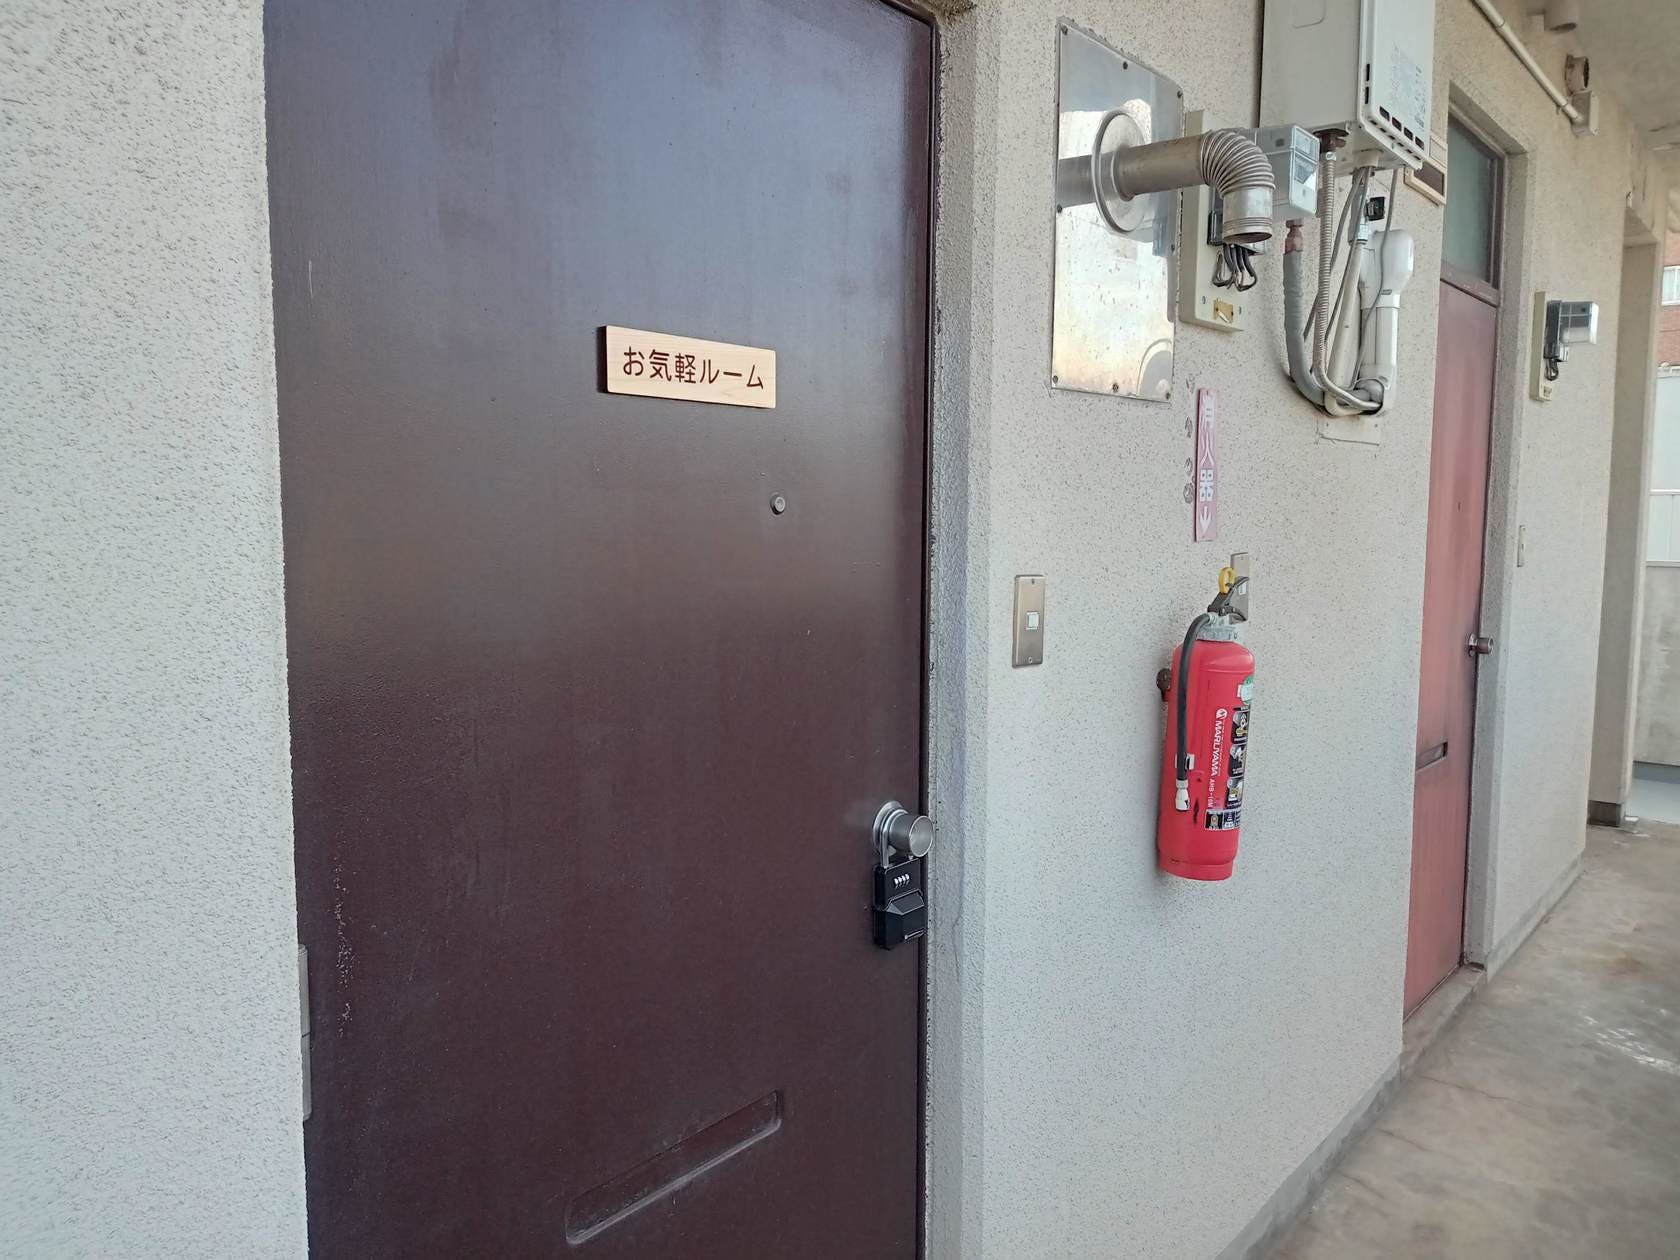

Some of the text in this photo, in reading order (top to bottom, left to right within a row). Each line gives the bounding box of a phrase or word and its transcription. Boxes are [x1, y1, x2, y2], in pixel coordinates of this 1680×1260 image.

[623, 346, 764, 389] お気軽ルーム
[1200, 395, 1215, 502] 消火器
[1210, 720, 1221, 777] MARUYAMA
